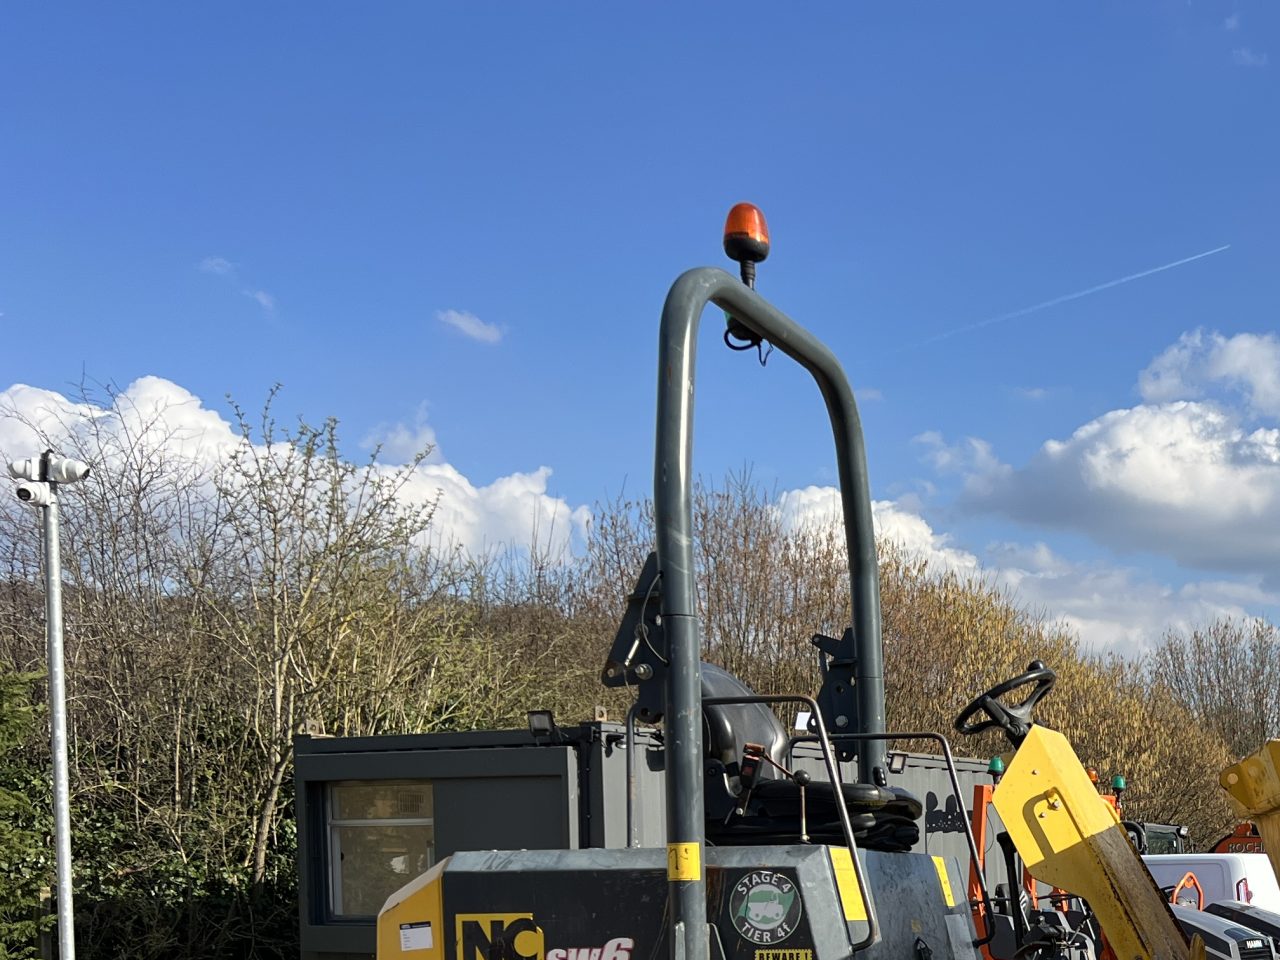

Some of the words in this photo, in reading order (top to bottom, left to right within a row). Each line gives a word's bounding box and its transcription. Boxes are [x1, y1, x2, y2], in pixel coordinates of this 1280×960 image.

[737, 873, 779, 895] STAGE
[782, 883, 792, 893] 4
[741, 922, 771, 942] TIER
[777, 922, 791, 937] 4f
